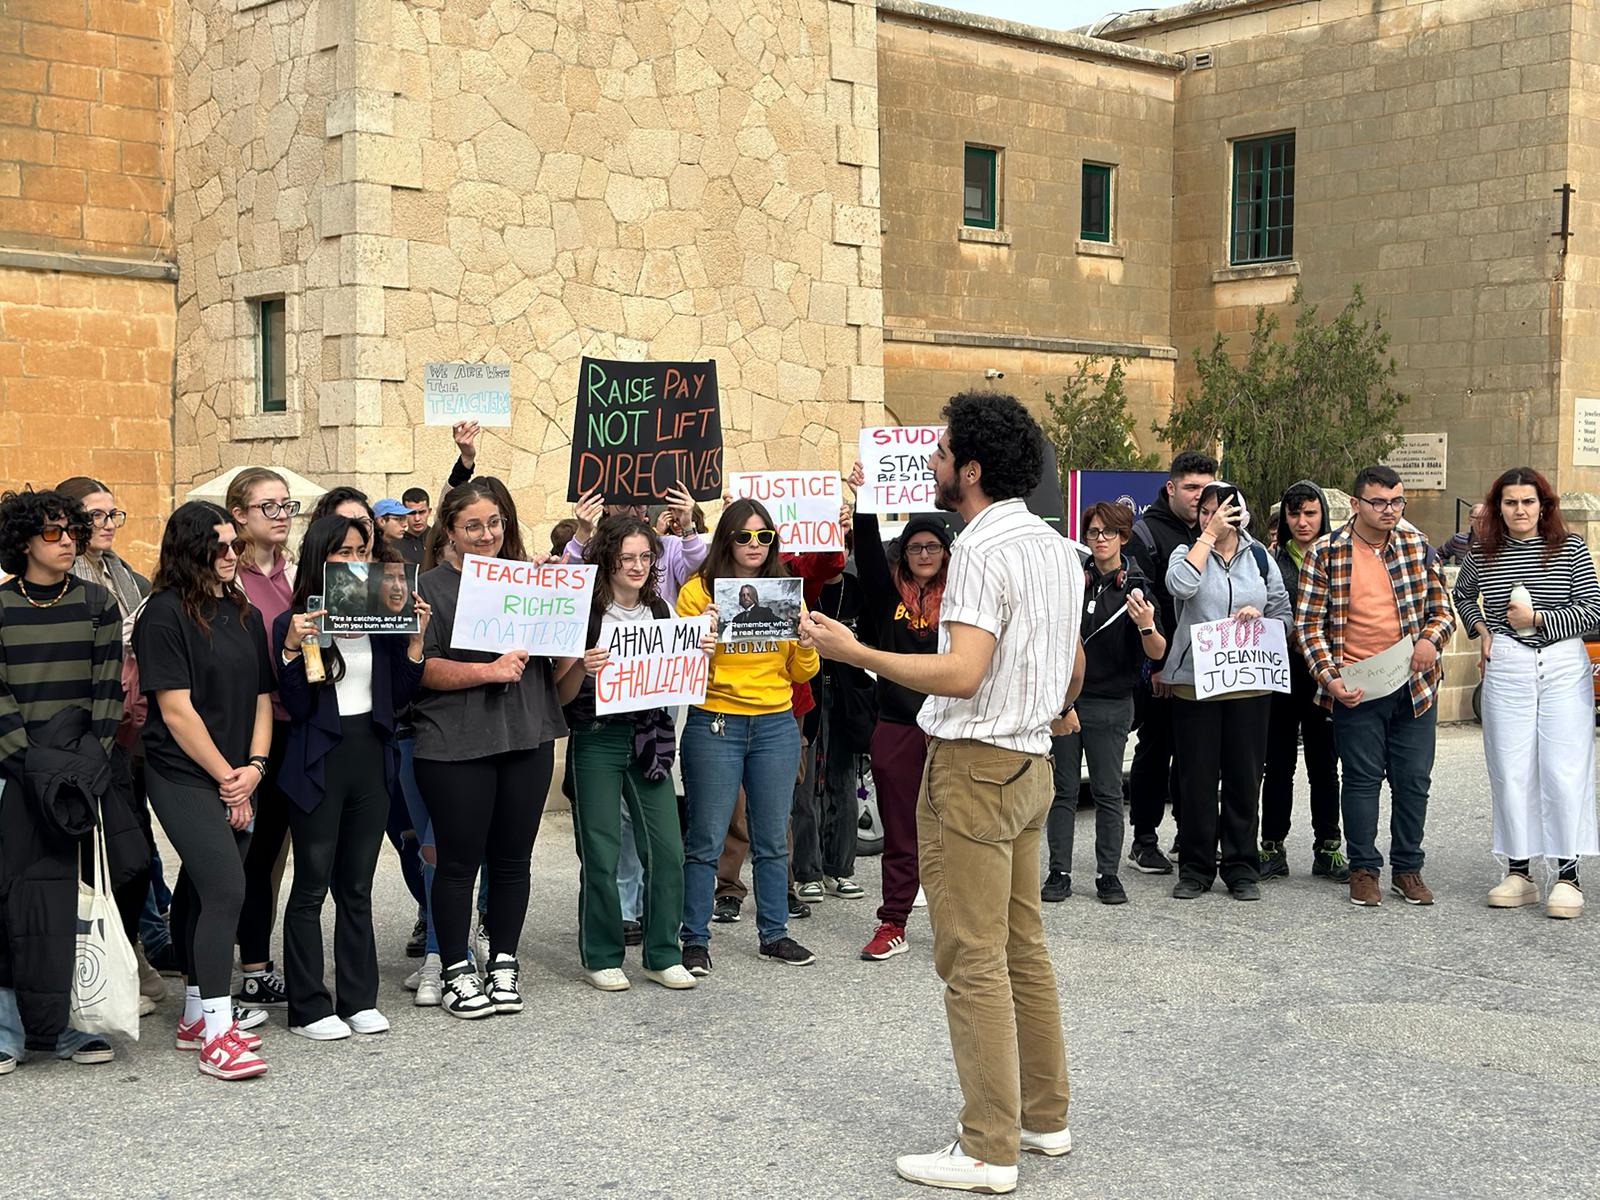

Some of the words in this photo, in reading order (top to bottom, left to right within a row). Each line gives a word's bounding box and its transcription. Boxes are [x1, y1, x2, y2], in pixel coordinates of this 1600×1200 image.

[454, 364, 483, 379] ARE
[427, 379, 459, 392] THE
[588, 363, 656, 407] RAISE
[663, 368, 705, 400] PAY
[587, 410, 649, 448] NOT
[656, 408, 715, 442] LIFT
[577, 447, 721, 498] DIRECTIVES
[879, 454, 931, 473] STAN
[739, 474, 837, 501] JUSTICE
[878, 472, 935, 482] BESID
[873, 484, 936, 505] TEACH
[780, 502, 797, 523] IN
[776, 520, 843, 547] CATION
[470, 560, 590, 590] TEACHERS'
[503, 594, 576, 617] RIGHTS
[724, 641, 780, 654] ROMA
[1197, 620, 1266, 652] STOP
[1214, 649, 1283, 667] DELAYING
[1202, 667, 1288, 693] JUSTICE
